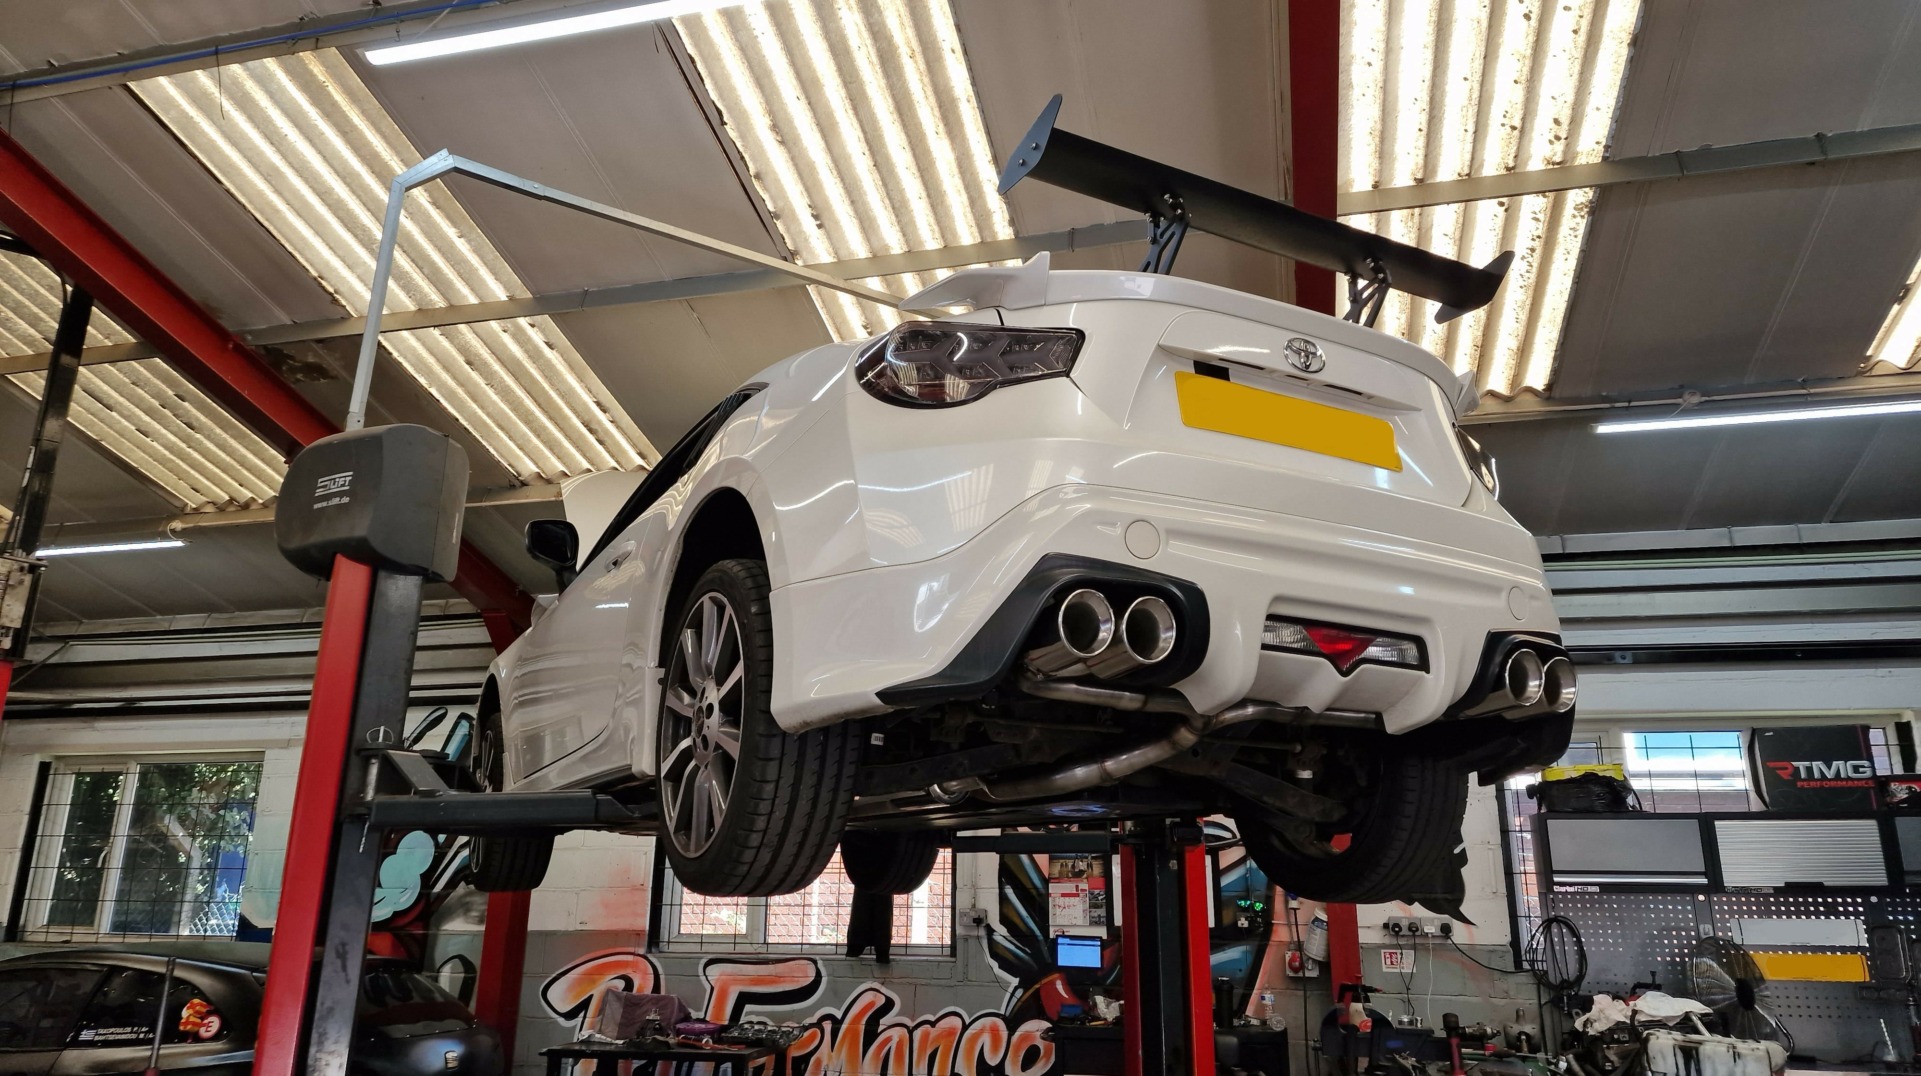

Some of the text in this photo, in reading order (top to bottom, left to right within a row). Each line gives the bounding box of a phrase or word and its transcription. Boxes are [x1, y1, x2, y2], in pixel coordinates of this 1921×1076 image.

[313, 495, 350, 510] www.slift.de
[1766, 760, 1873, 779] RTMG
[1796, 780, 1875, 788] PERFORMANCE
